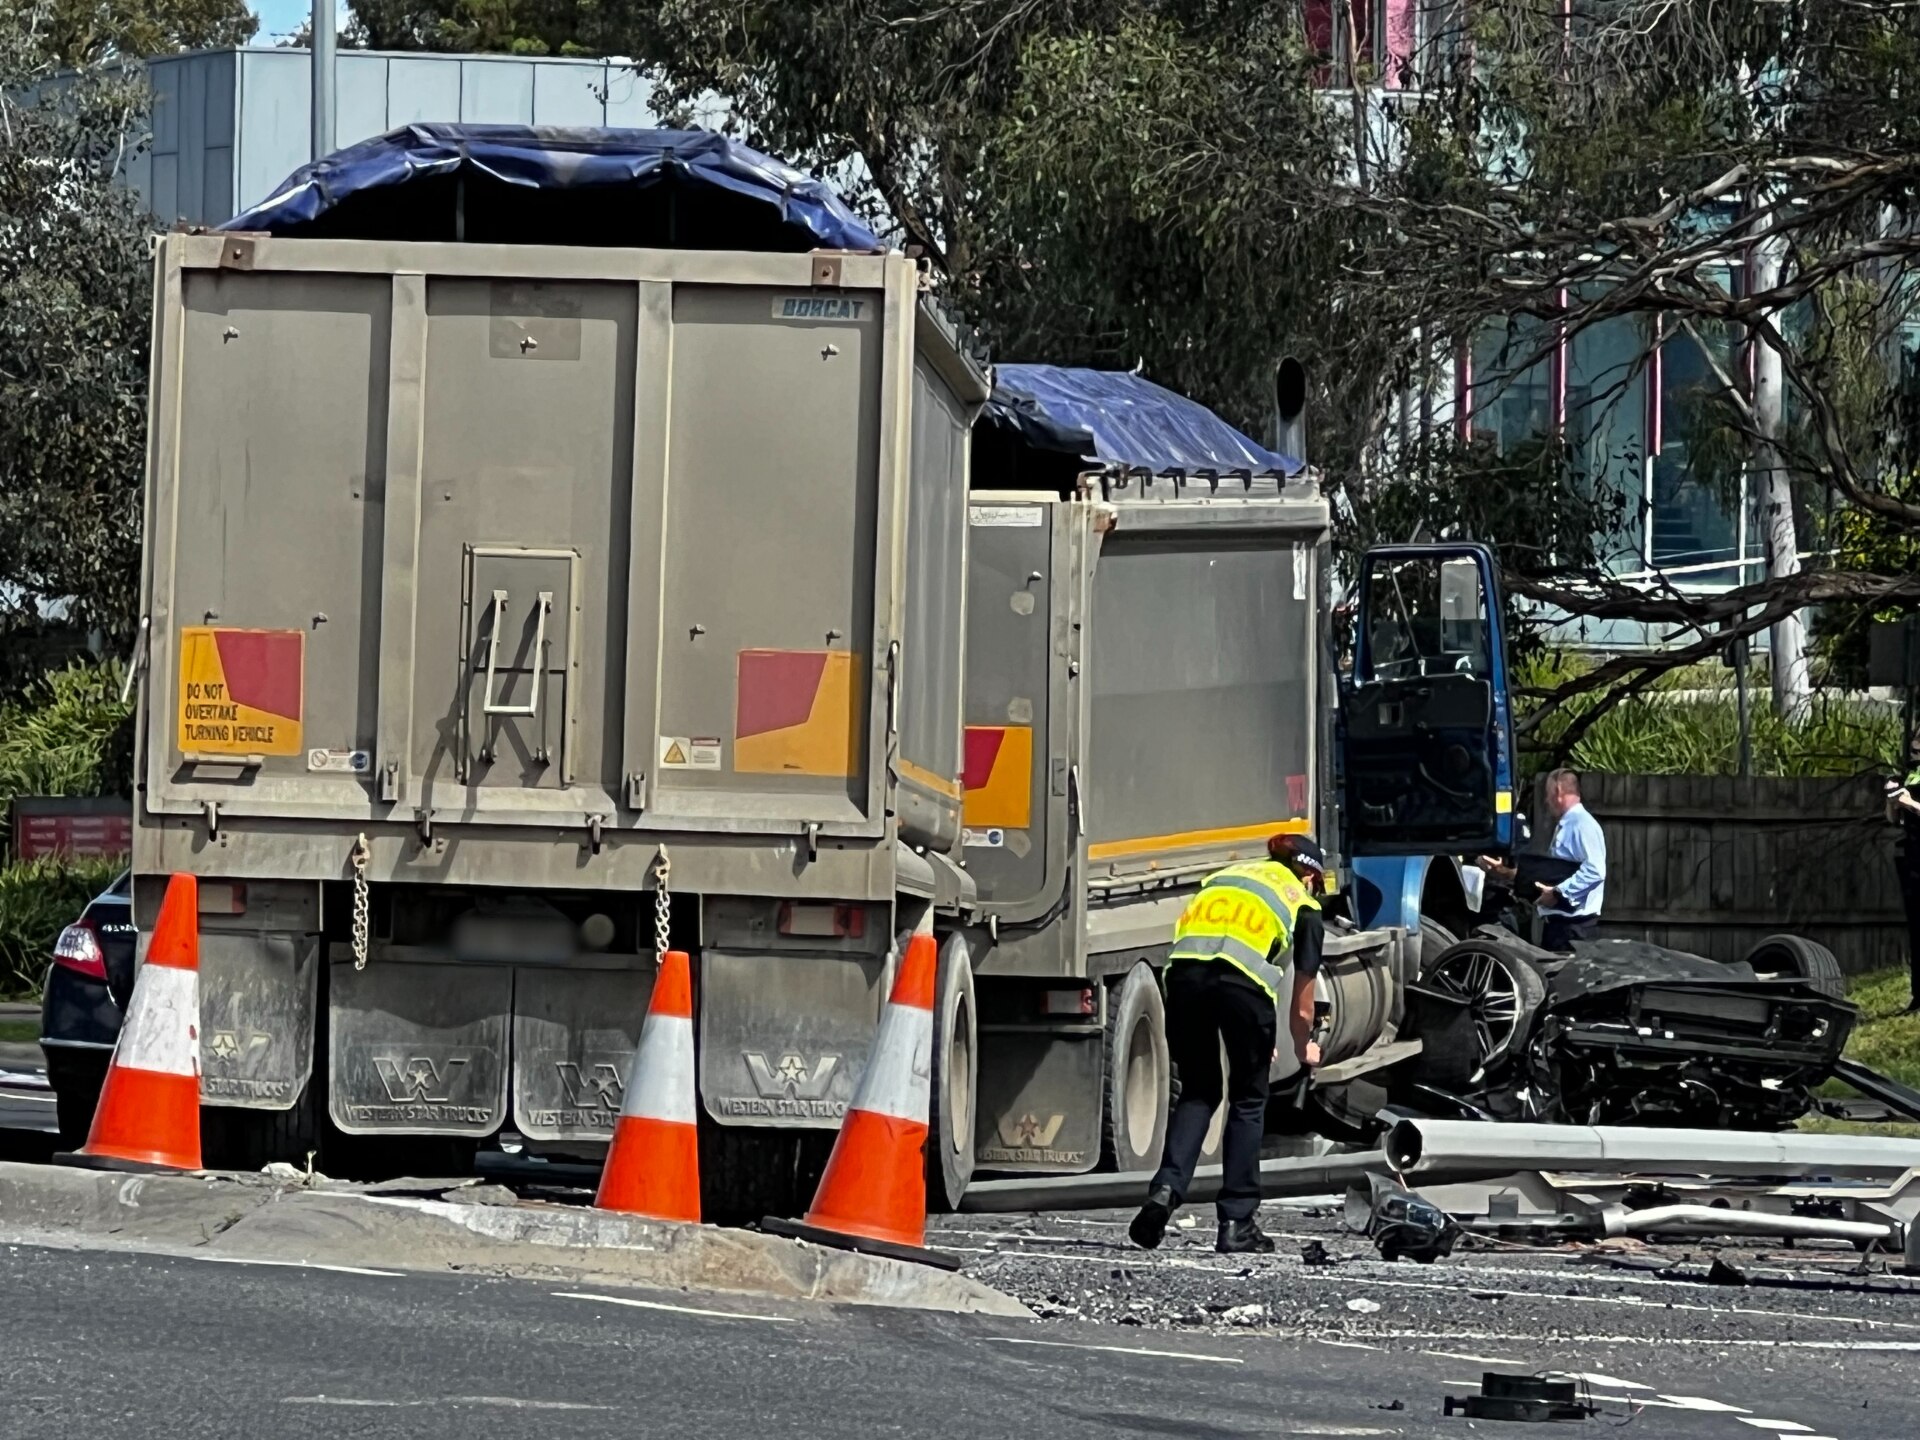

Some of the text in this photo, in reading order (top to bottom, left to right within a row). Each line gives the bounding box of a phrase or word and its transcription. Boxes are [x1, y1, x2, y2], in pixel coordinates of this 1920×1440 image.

[186, 682, 224, 700] DO NOT
[185, 703, 238, 721] OVERTAKE
[184, 723, 274, 743] TURNING VEHICLE
[406, 1104, 439, 1121] STAR
[442, 1106, 492, 1124] TRUCKS
[719, 1097, 848, 1119] WESTERN STAR TRUC
[528, 1109, 616, 1128] WESTERN STA
[1015, 1148, 1041, 1163] STAR
[1043, 1149, 1080, 1164] TRUCKS
